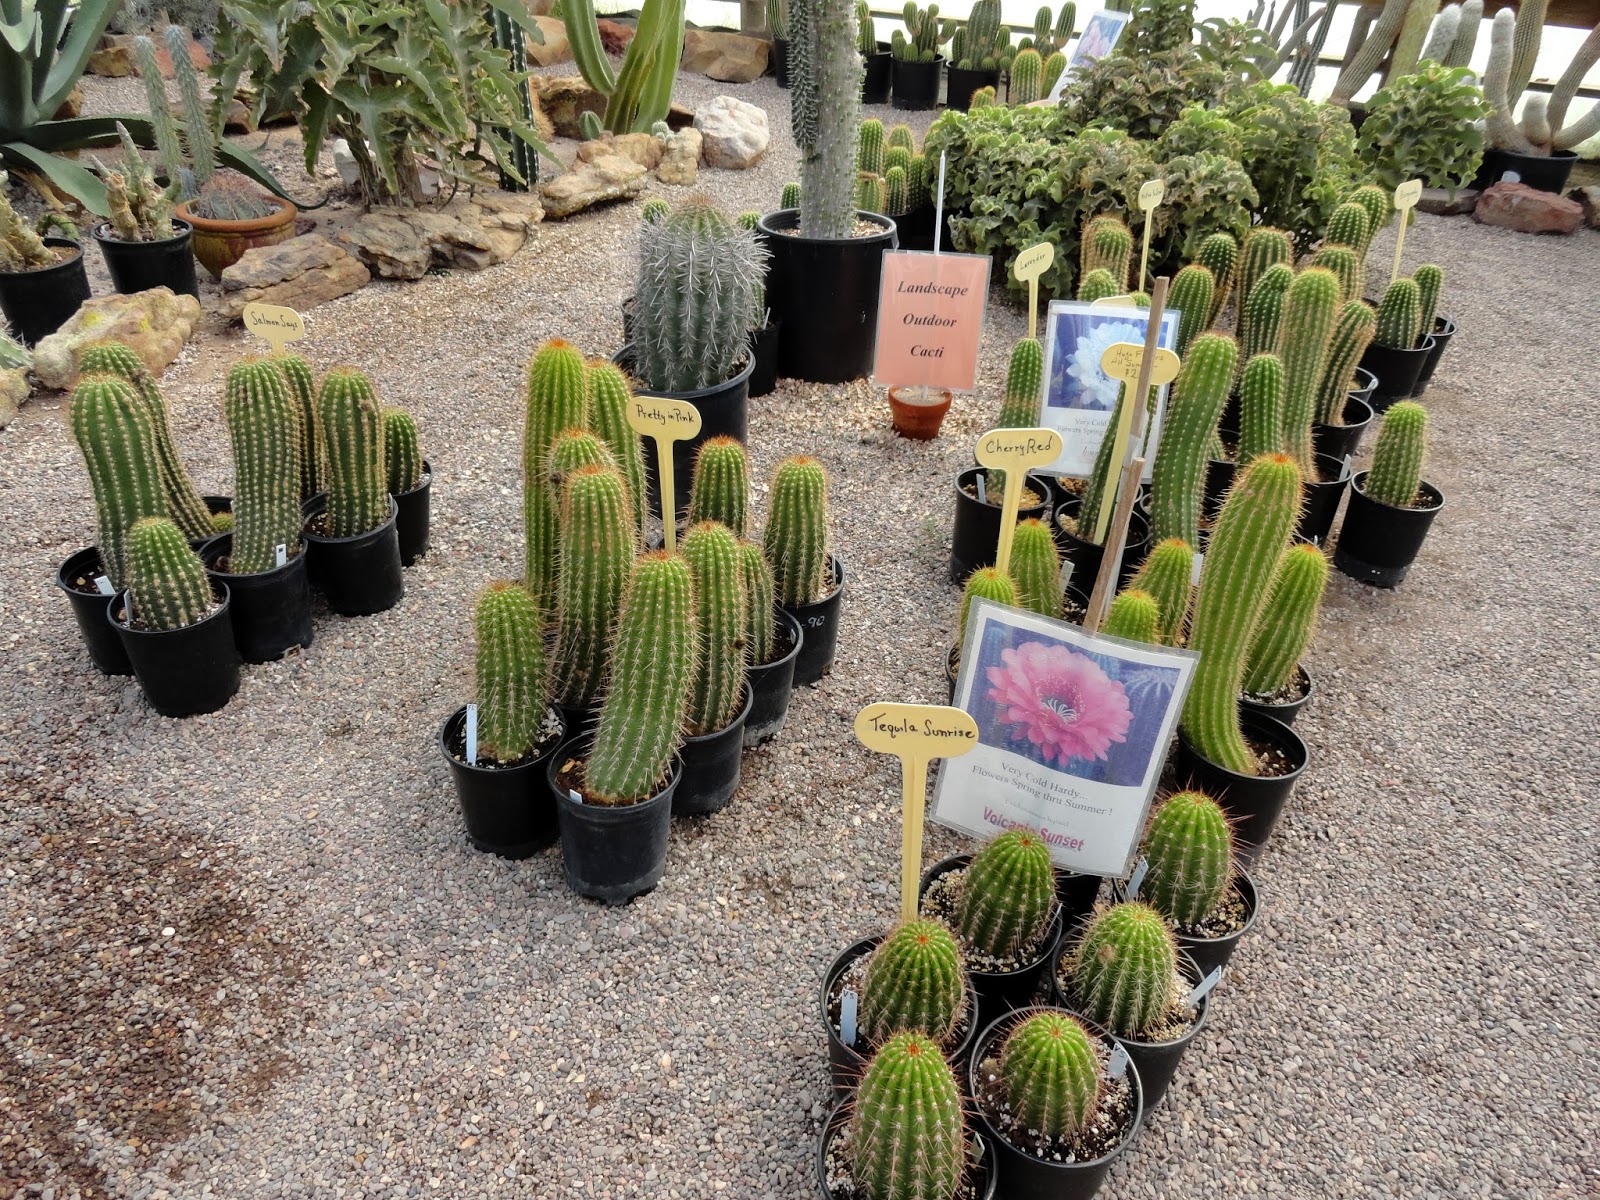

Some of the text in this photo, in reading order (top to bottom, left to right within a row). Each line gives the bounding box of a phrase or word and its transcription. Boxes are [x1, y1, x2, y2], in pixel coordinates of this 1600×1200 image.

[897, 281, 968, 298] Landscape
[251, 311, 298, 331] Salmon Says
[903, 313, 958, 328] Outdoor
[910, 345, 945, 358] Cacti
[636, 404, 666, 425] Pretty
[673, 408, 695, 423] Pink
[986, 435, 1053, 456] Cherry Red
[868, 712, 976, 739] Tequila Sunrise
[1002, 762, 1023, 778] Very
[1025, 772, 1048, 788] Cold
[972, 765, 1009, 783] Flowers
[1012, 777, 1041, 798] Spring
[1043, 792, 1062, 805] thru
[1064, 799, 1107, 815] Summer
[1040, 828, 1085, 851] Sunset
